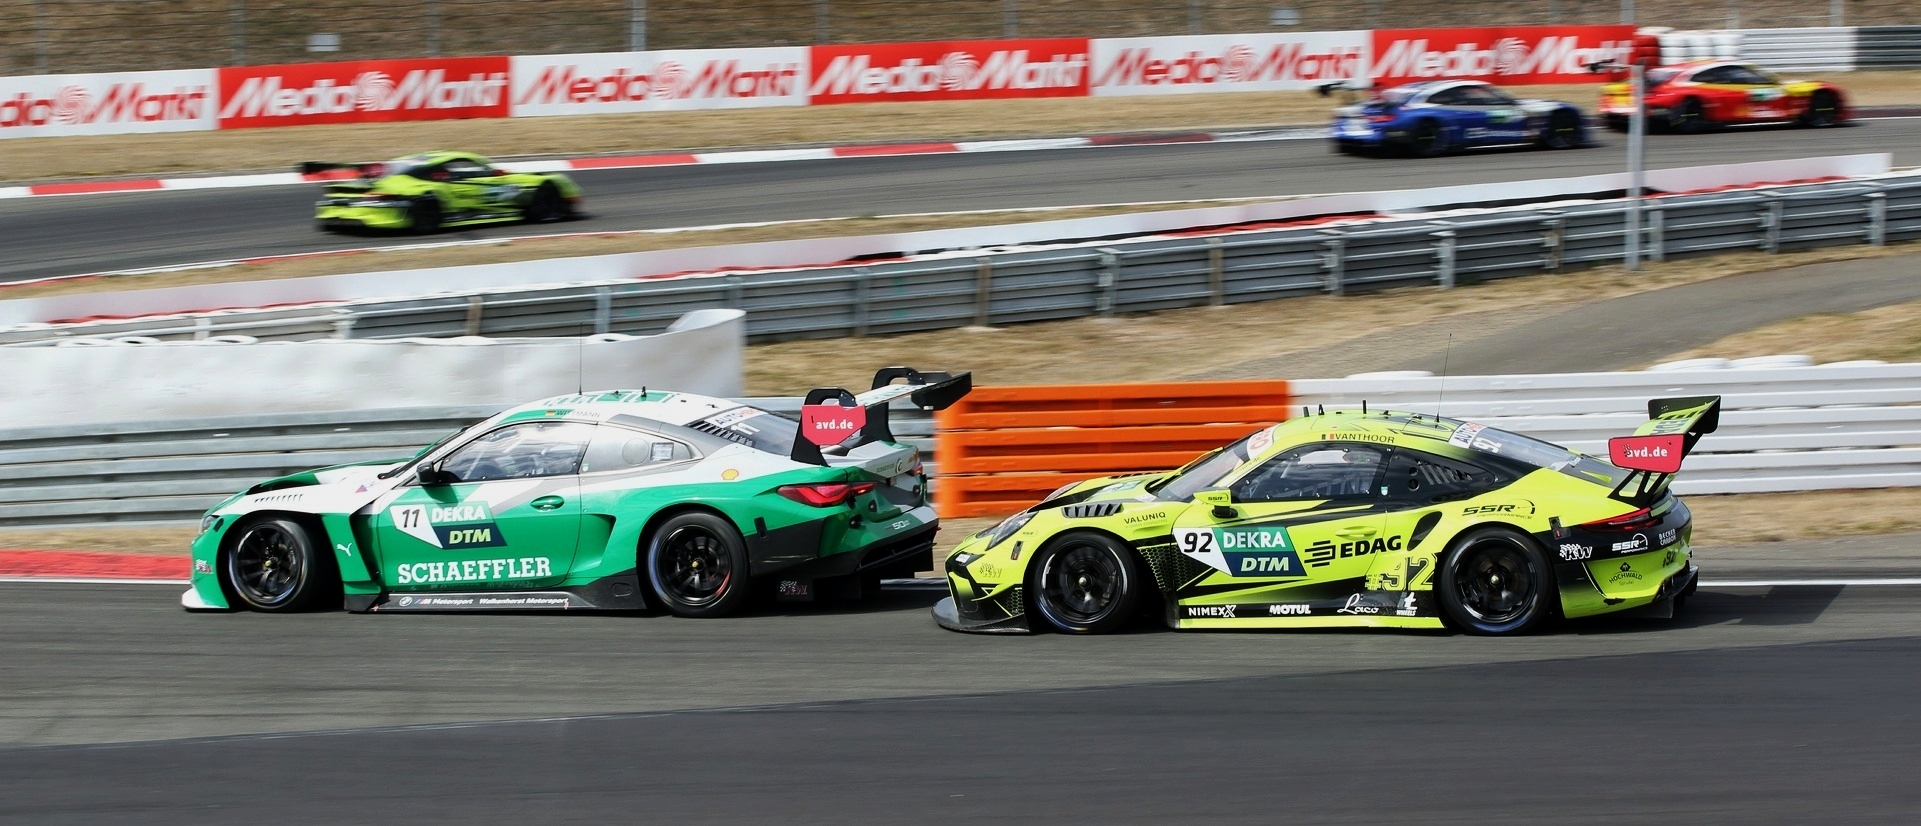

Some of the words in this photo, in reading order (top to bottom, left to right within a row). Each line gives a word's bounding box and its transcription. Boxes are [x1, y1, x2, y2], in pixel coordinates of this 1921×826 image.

[816, 418, 854, 430] avd.de
[1335, 433, 1395, 444] VANTHOOR
[1626, 446, 1668, 458] avd.de
[402, 509, 420, 528] 11
[431, 505, 487, 523] DEKRA
[1124, 511, 1166, 524] VALUNIQ
[449, 528, 492, 544] DTM
[1184, 532, 1213, 553] 92
[1223, 531, 1286, 549] DEKRA
[1340, 535, 1401, 559] EDAG
[1611, 539, 1640, 552] SSR
[397, 556, 552, 584] SCHAEFFLER
[1240, 557, 1290, 572] DTM
[1608, 572, 1643, 584] HOCHWALD
[432, 598, 474, 606] Motorsport
[525, 597, 569, 606] Motorsport
[1336, 593, 1380, 615] Laco
[1269, 604, 1312, 615] MOTUL
